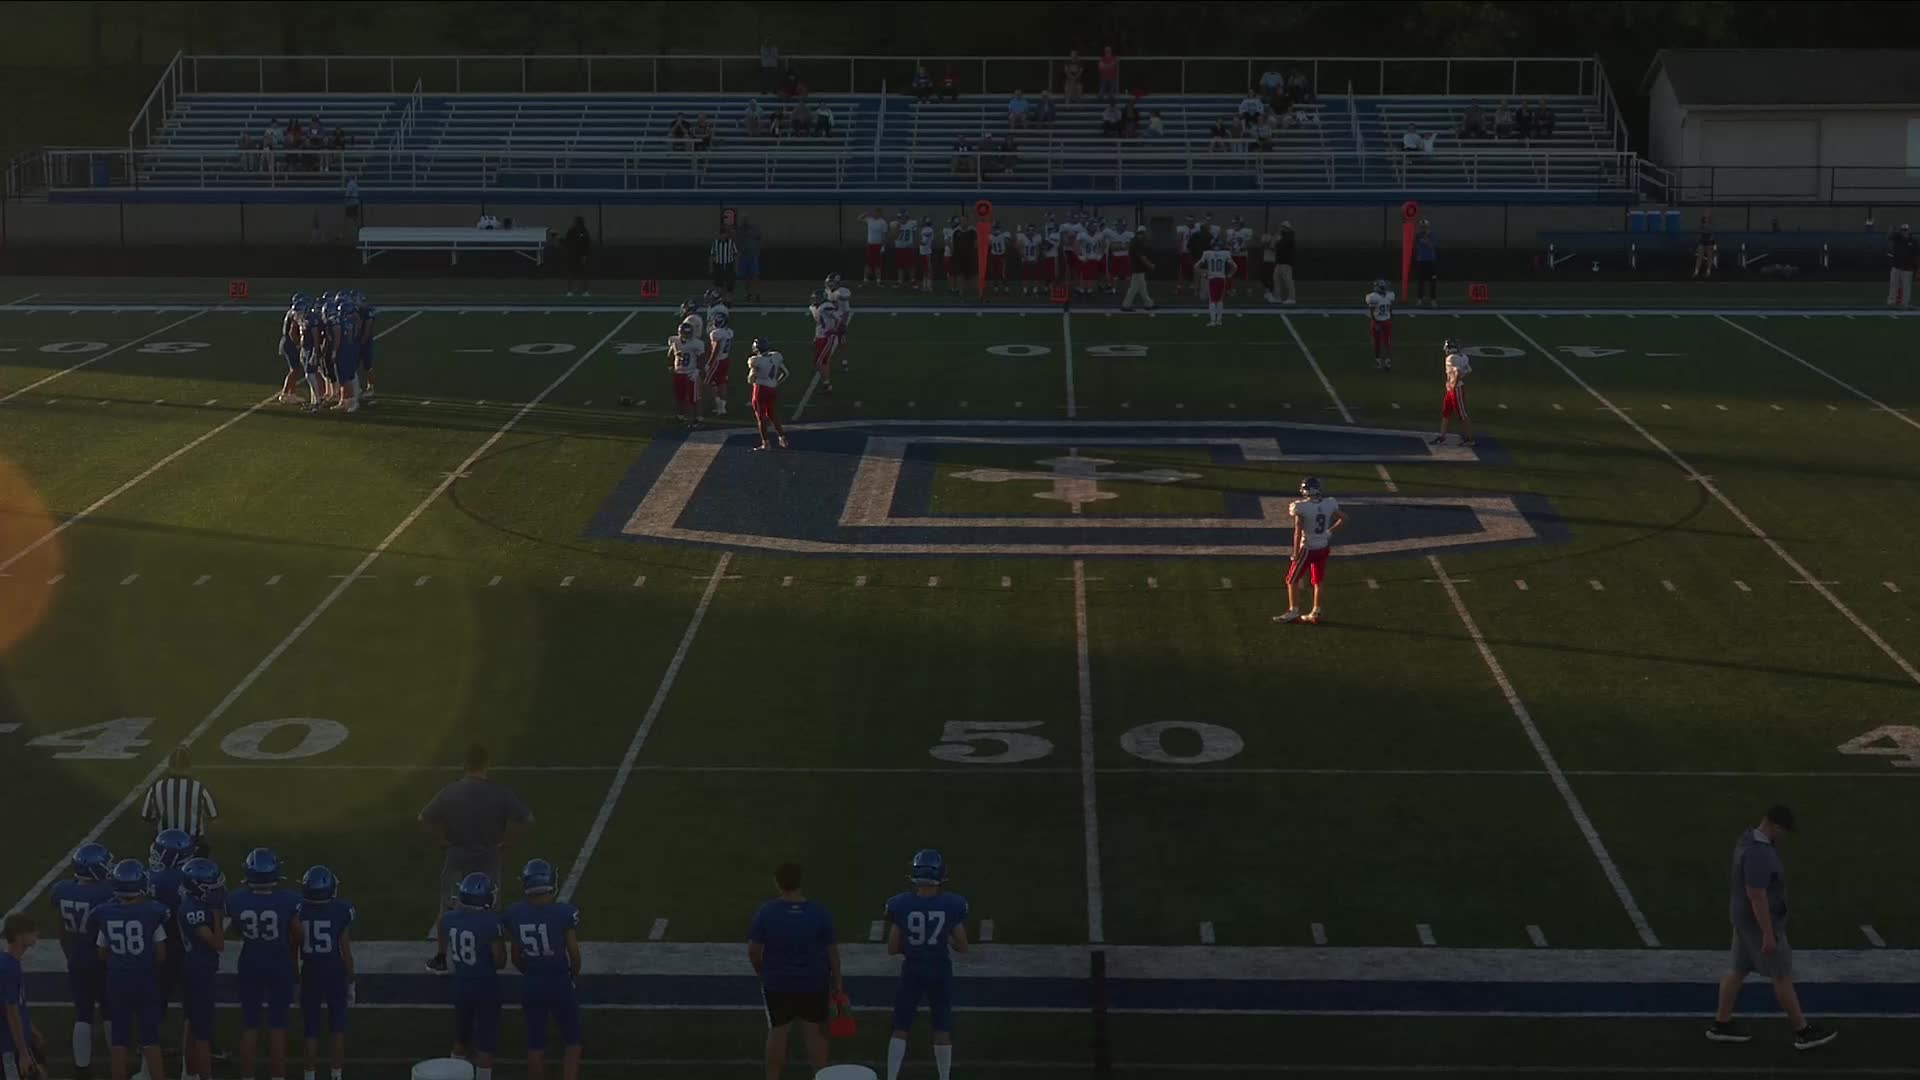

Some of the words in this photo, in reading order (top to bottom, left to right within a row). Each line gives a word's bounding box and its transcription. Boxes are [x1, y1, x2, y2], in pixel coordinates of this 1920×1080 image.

[1209, 257, 1222, 273] 10
[1314, 513, 1326, 534] 3
[59, 898, 91, 935] 57
[185, 910, 206, 926] 88
[239, 909, 280, 942] 33
[906, 910, 946, 947] 97
[105, 919, 146, 956] 58
[300, 919, 333, 955] 15
[448, 926, 478, 967] 18
[518, 922, 556, 958] 51
